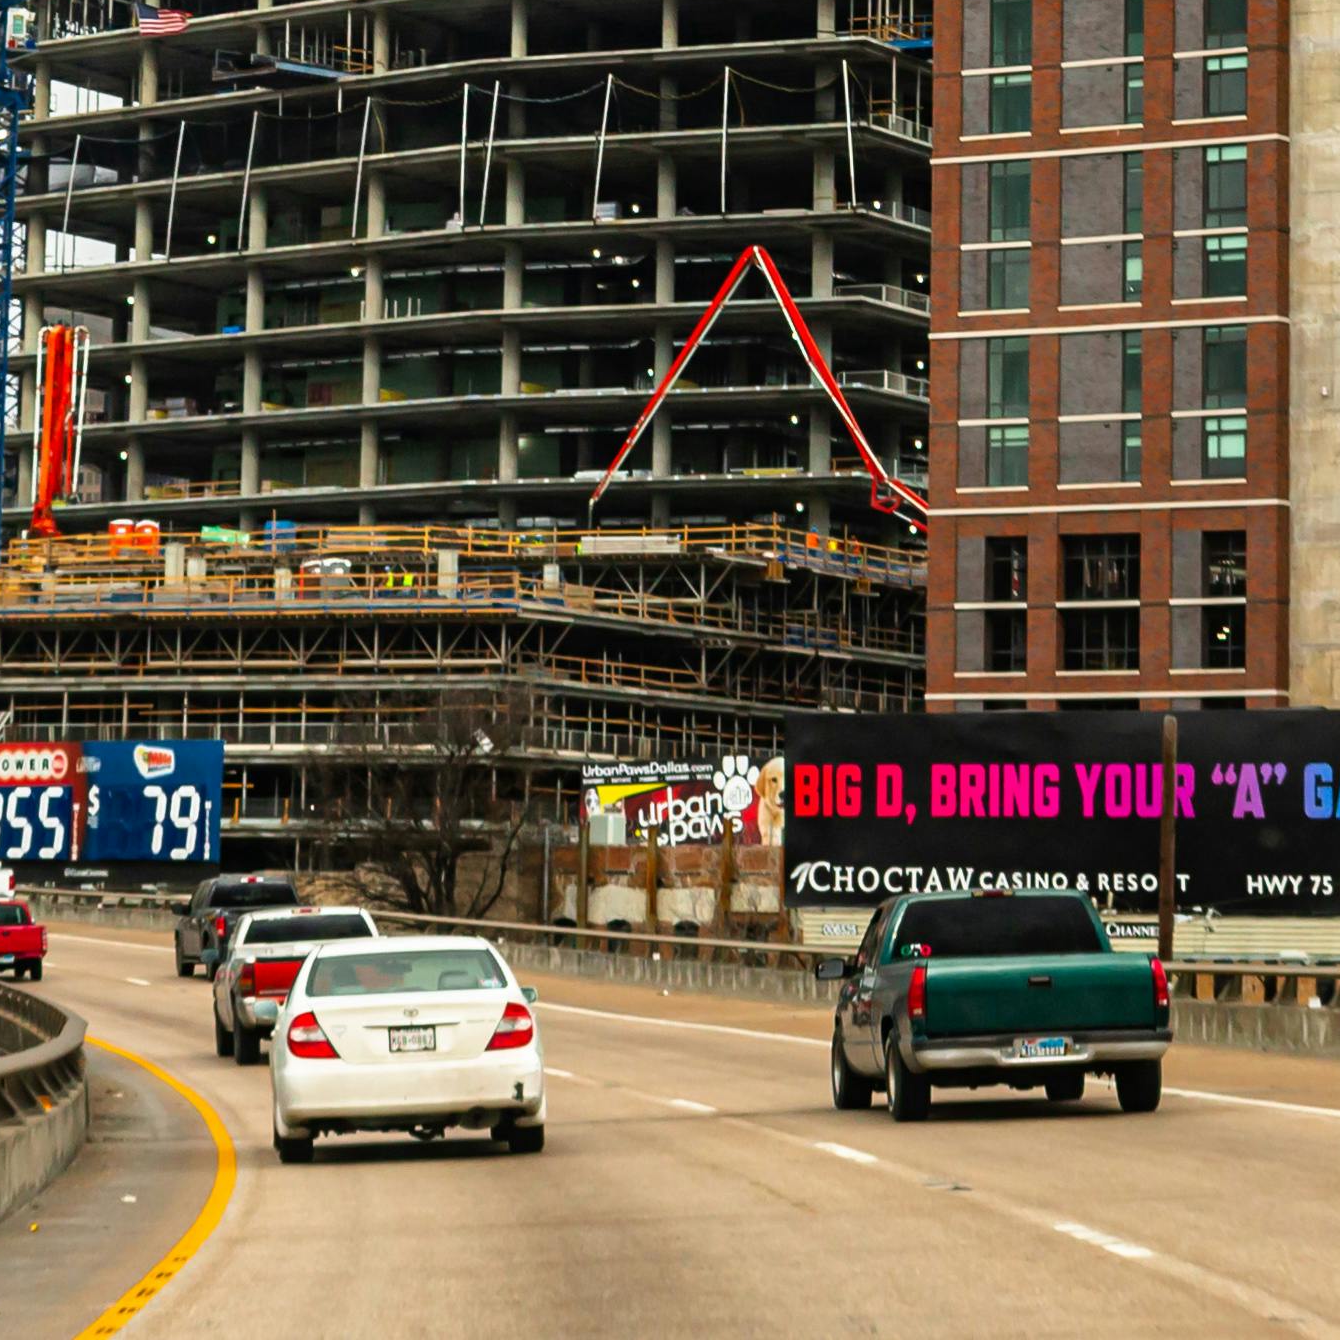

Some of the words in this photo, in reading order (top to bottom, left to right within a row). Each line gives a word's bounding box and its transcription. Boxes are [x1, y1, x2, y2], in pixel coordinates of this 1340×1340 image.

[582, 761, 714, 778] UrbanPawsDallas.com
[637, 785, 723, 828] urban
[793, 762, 862, 818] BIG
[875, 762, 917, 826] D,
[930, 762, 1060, 819] BRING
[1074, 762, 1196, 820] YOUR
[87, 783, 100, 817] $
[142, 784, 201, 860] 79
[670, 808, 744, 848] paws
[808, 860, 974, 893] CHOCTAW
[978, 871, 1069, 891] CASINO
[1075, 872, 1090, 892] &
[1097, 872, 1191, 893] RESOT
[1246, 874, 1303, 896] HWY
[1310, 875, 1333, 896] 75
[1105, 922, 1160, 938] CHANNE
